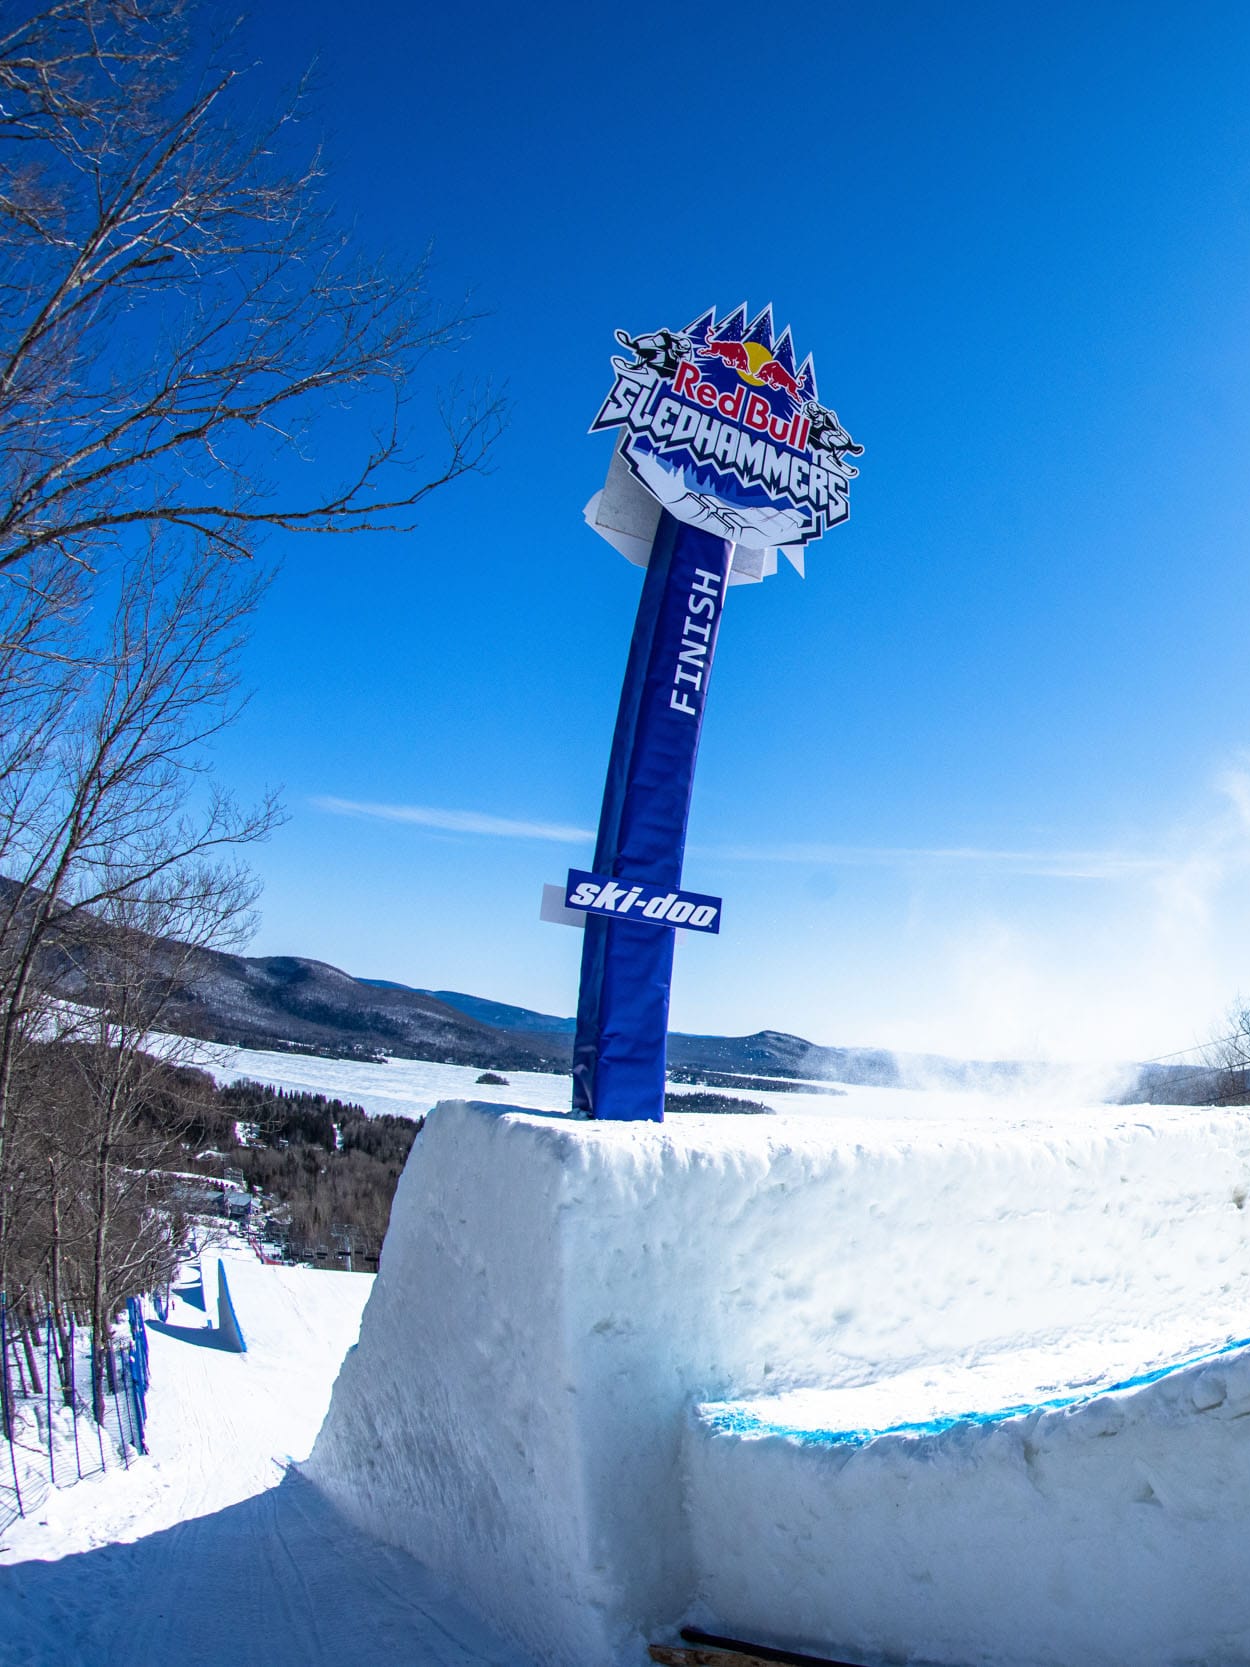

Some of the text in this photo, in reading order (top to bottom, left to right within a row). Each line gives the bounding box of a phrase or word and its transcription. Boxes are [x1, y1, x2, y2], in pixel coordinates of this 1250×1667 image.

[594, 375, 848, 525] SLEDHAMMERS
[675, 363, 810, 450] Red Bull
[670, 568, 721, 715] FINISH
[569, 880, 717, 926] ski-doo
